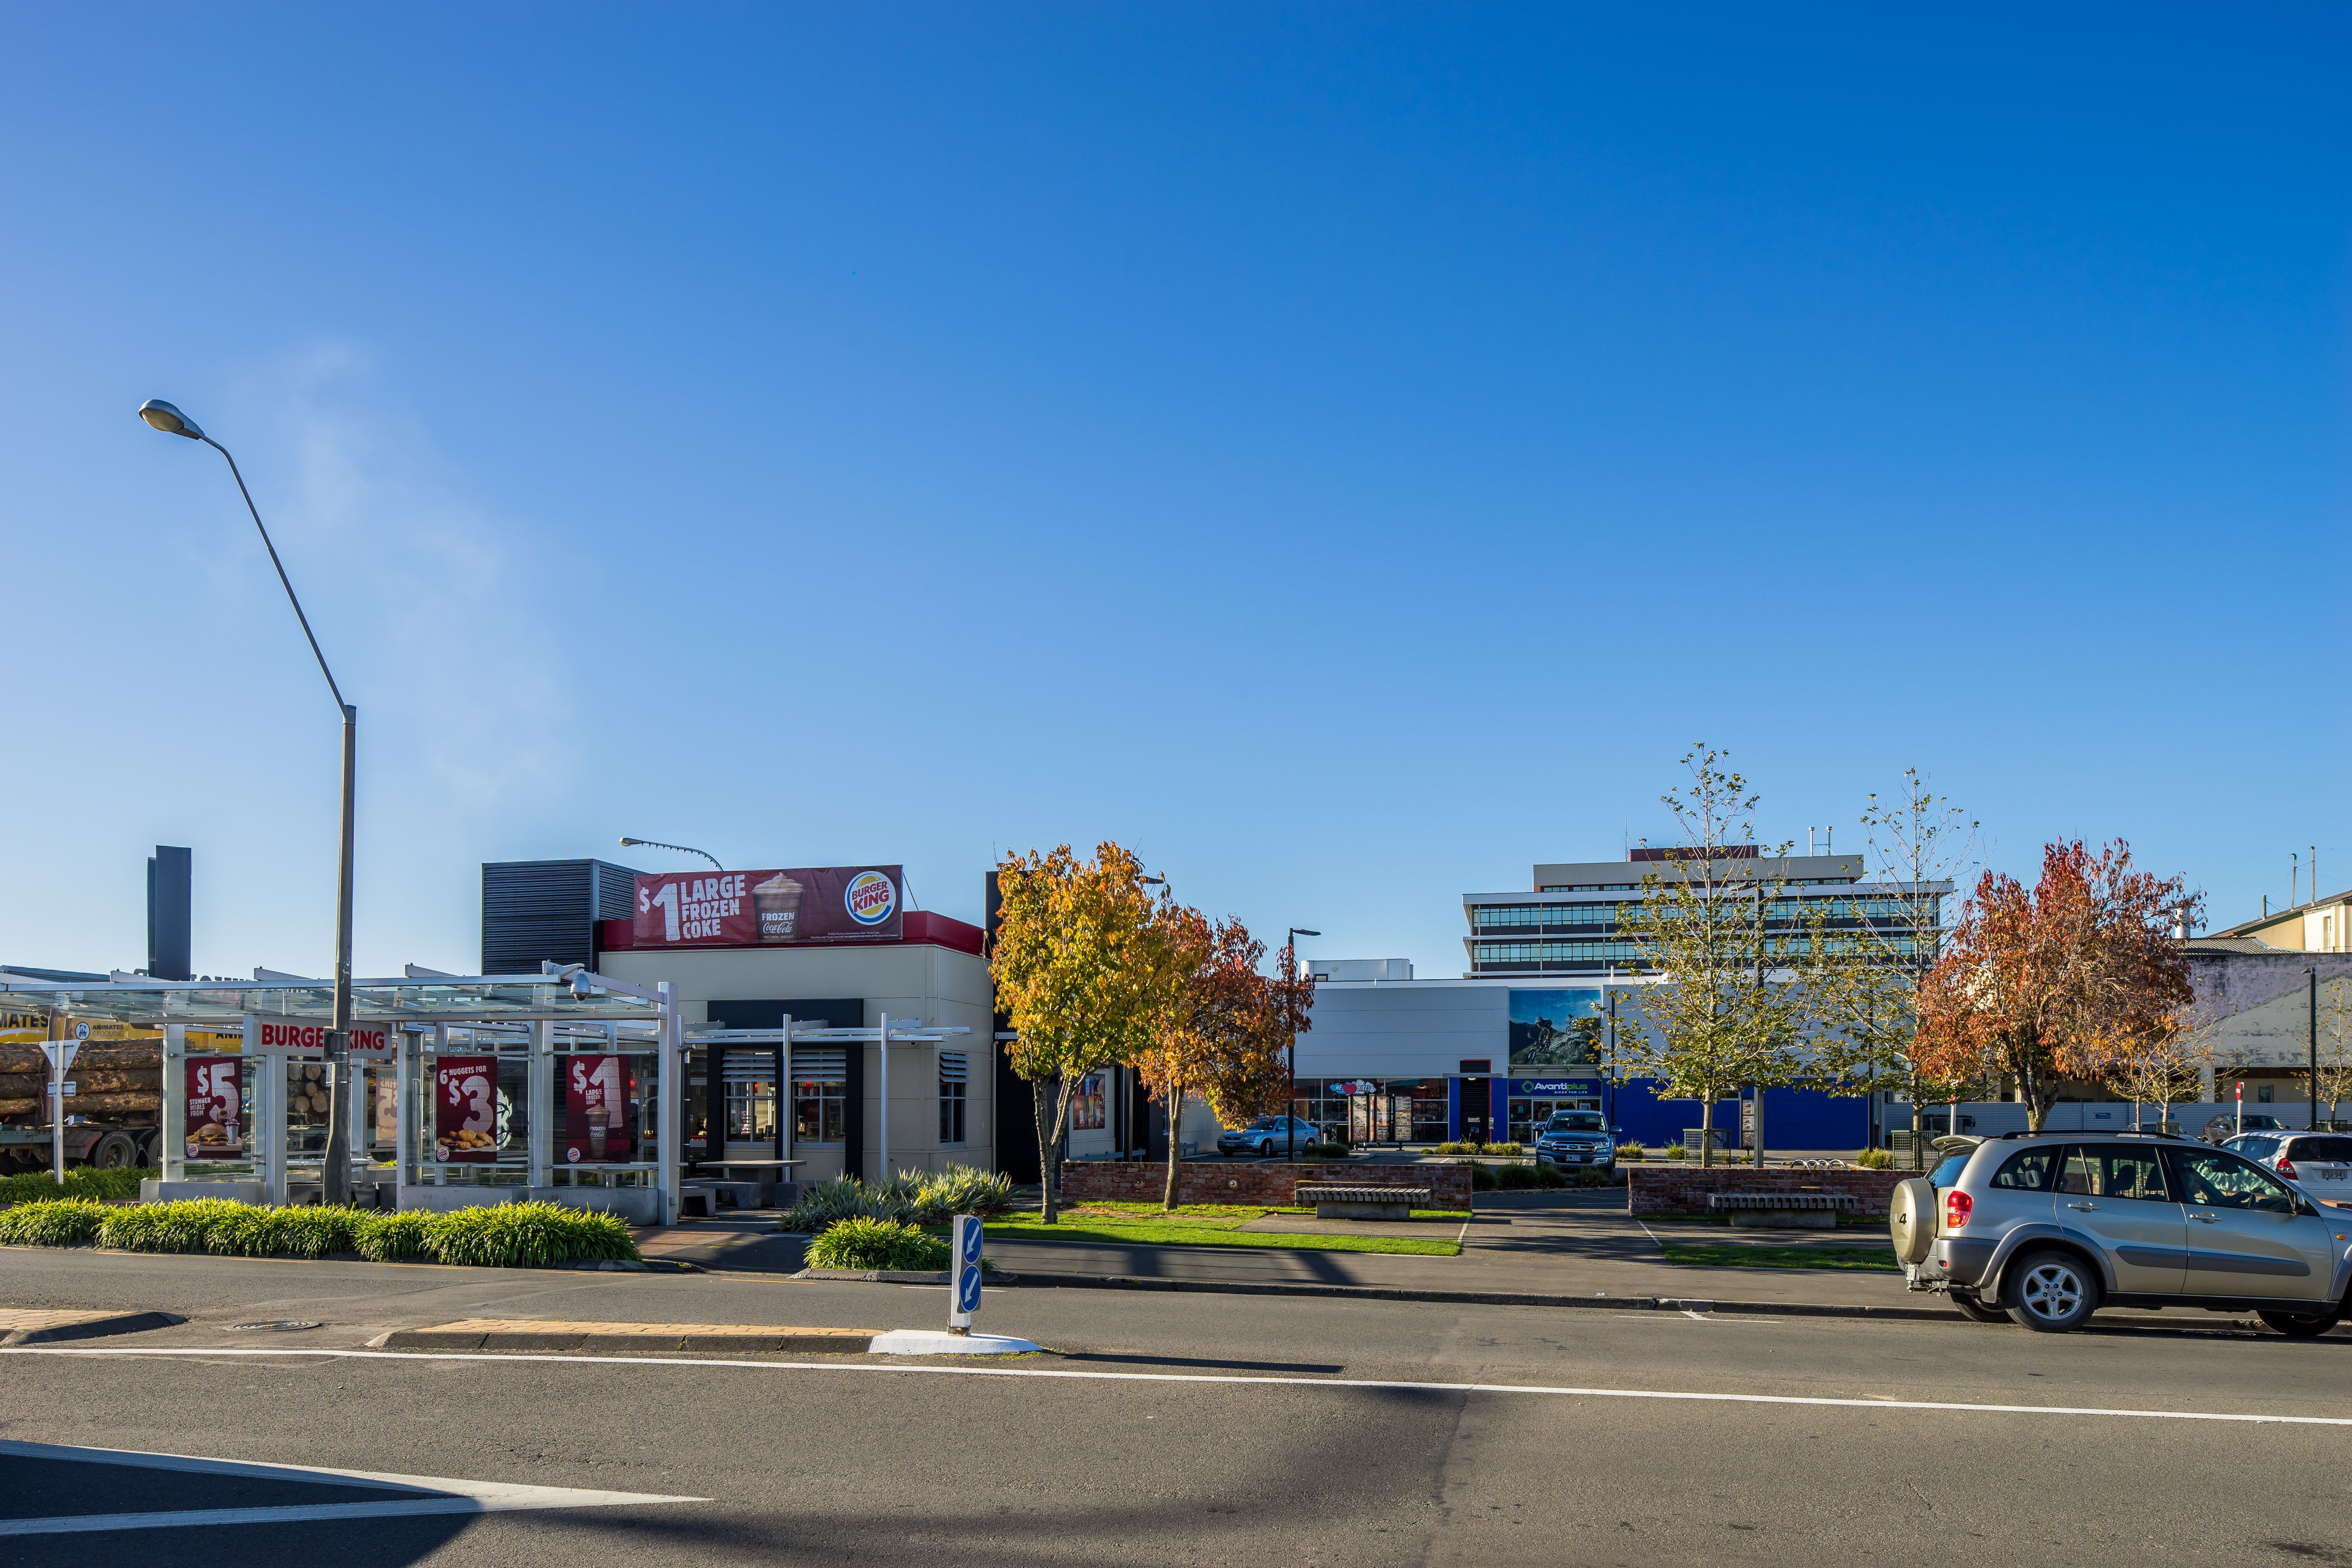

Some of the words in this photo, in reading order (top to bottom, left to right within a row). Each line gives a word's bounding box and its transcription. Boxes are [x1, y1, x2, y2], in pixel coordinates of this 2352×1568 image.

[681, 875, 746, 903] LARGE
[852, 881, 888, 901] BURGER
[639, 883, 680, 941] $1
[682, 899, 740, 921] FROZEN
[853, 889, 889, 913] KING
[762, 912, 795, 921] FROZEN
[683, 919, 721, 938] COKE
[262, 1024, 324, 1048] BURGE
[440, 1070, 448, 1084] 6
[449, 1066, 474, 1076] NUGGETS
[476, 1065, 487, 1073] FOR
[573, 1057, 623, 1128] $1
[1534, 1083, 1588, 1091] Avantiplus
[449, 1076, 494, 1135] $3
